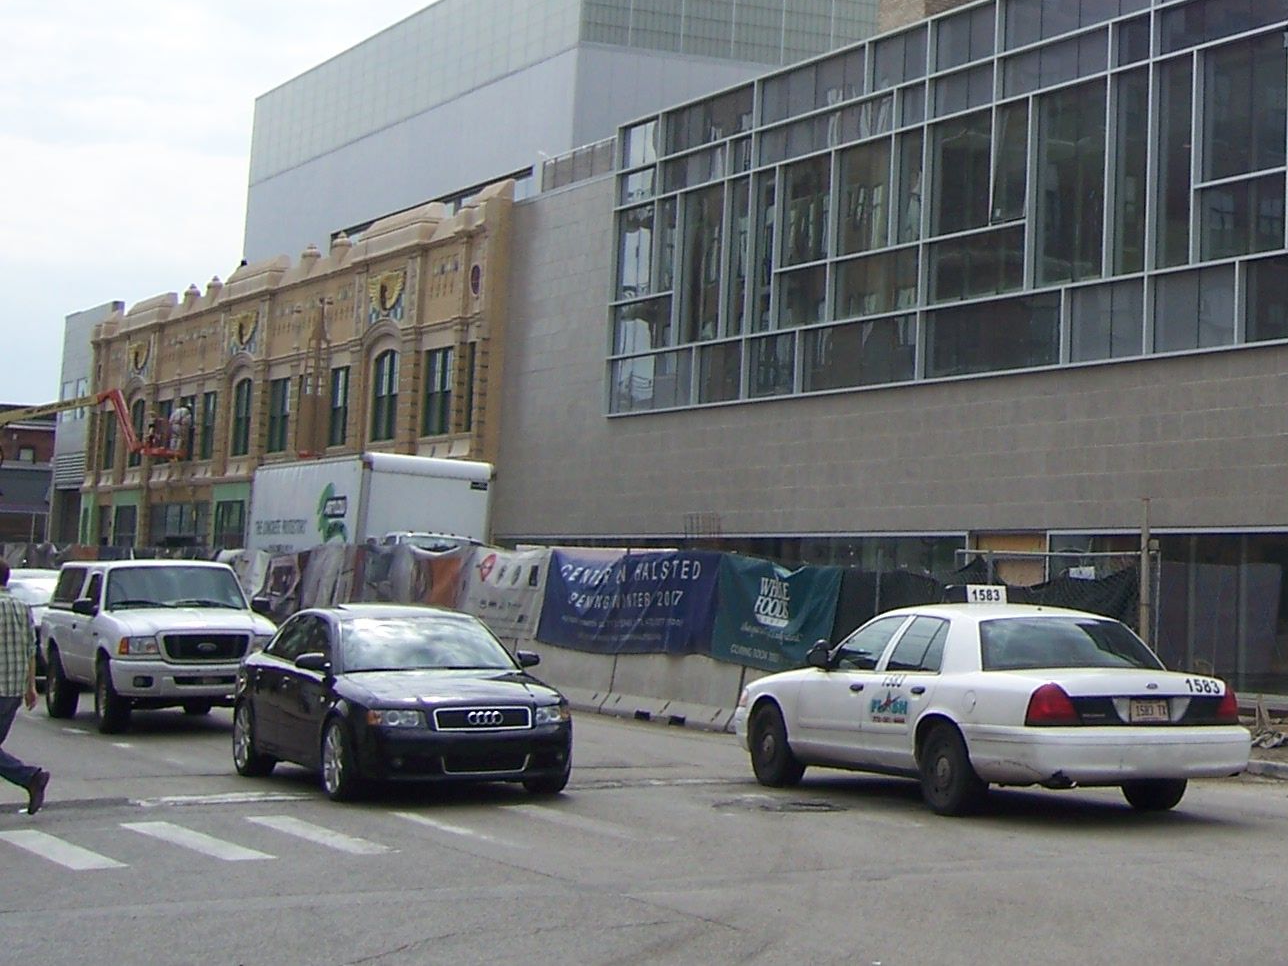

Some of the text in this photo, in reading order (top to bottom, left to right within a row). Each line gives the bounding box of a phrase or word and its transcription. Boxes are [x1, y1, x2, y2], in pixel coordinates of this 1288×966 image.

[634, 560, 702, 581] HALSTED
[972, 589, 1000, 601] 1583
[754, 595, 790, 619] FOODS
[1185, 678, 1220, 694] 1583
